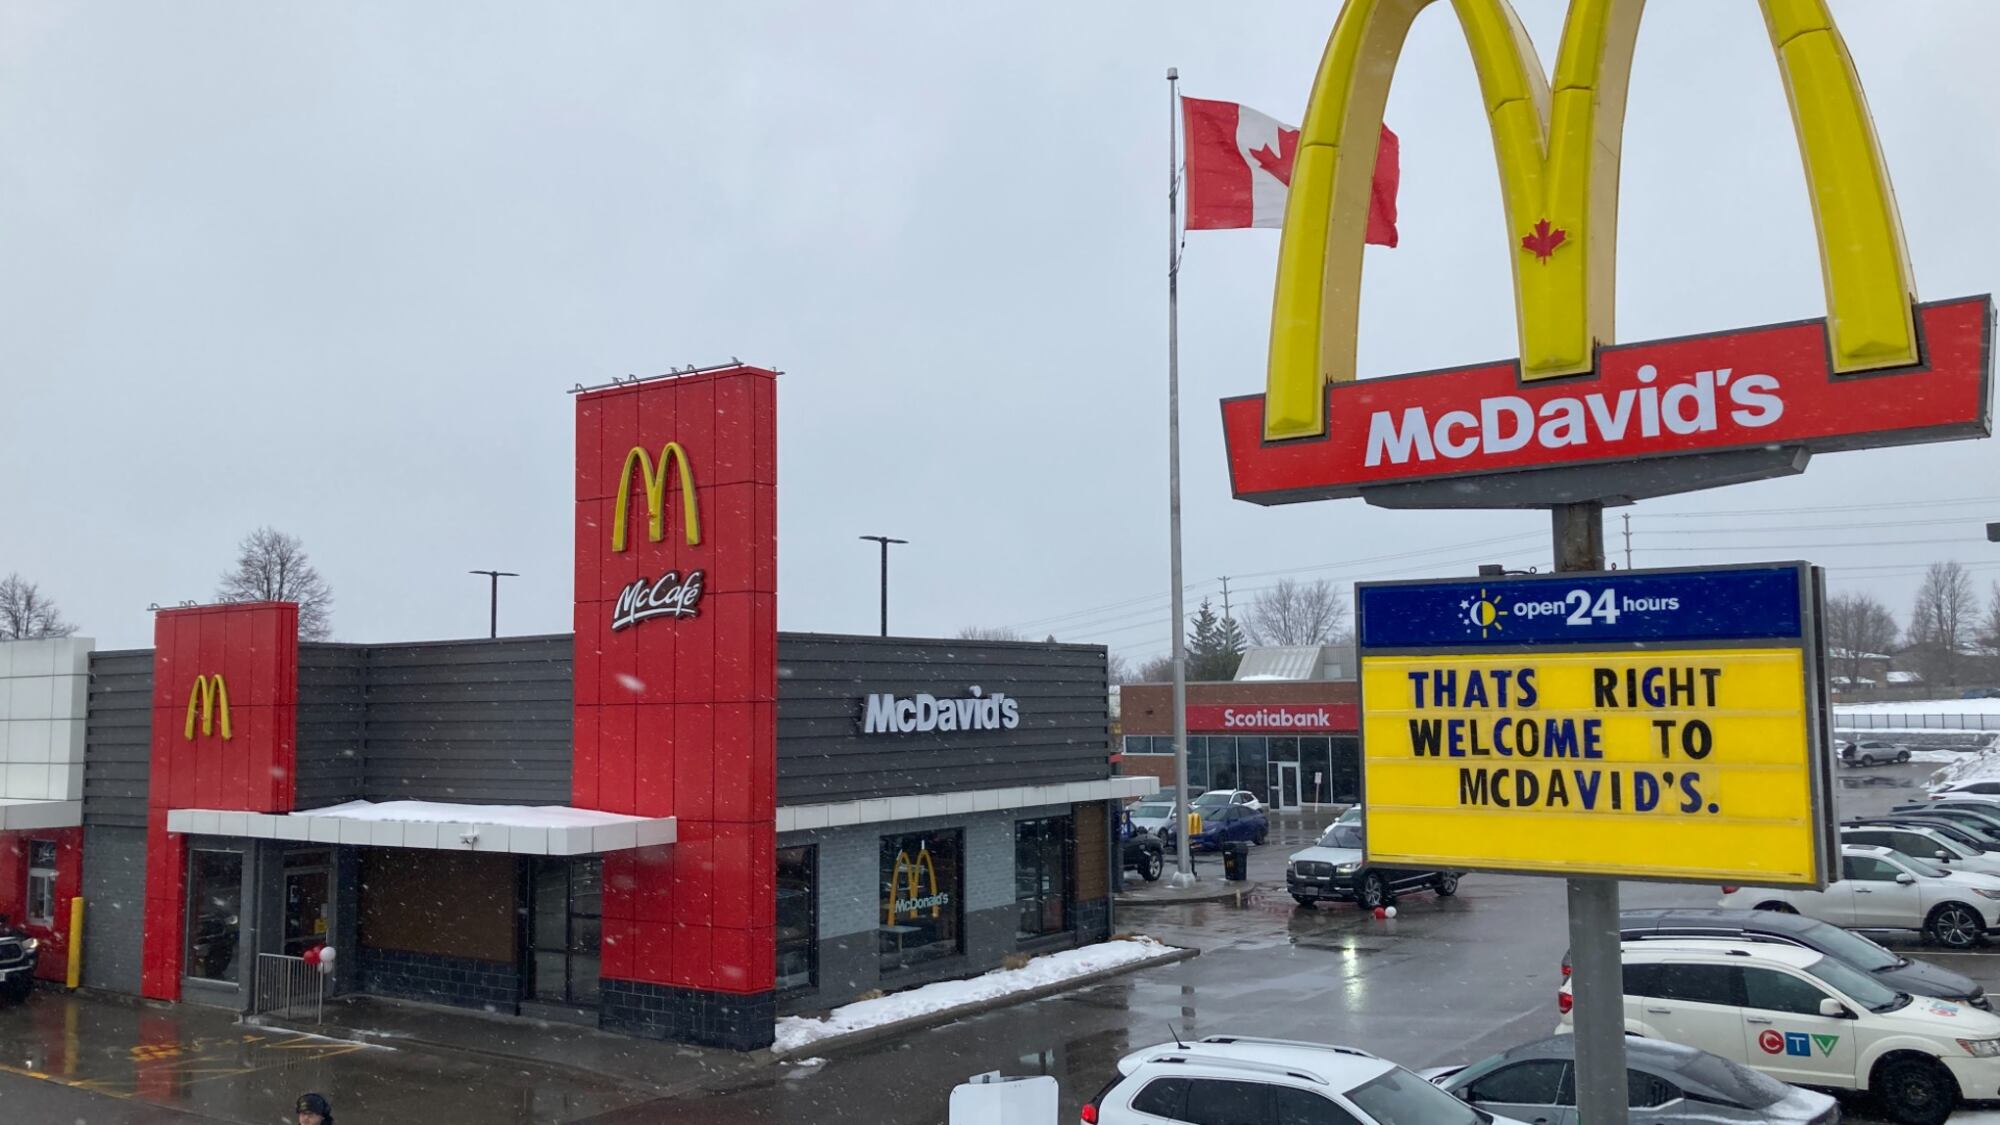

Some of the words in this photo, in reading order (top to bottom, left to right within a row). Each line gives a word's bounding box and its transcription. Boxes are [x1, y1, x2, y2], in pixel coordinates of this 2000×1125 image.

[1364, 364, 1784, 468] McDavid's
[613, 571, 701, 624] McCafé
[1513, 600, 1565, 620] open
[1565, 588, 1620, 626] 24
[1622, 595, 1680, 613] hours
[864, 685, 1020, 733] McDavid's
[1408, 668, 1537, 709] THATS
[1594, 667, 1722, 708] RIGHT
[1224, 708, 1331, 727] Scotiabank
[1409, 717, 1604, 759] WELCOME
[1652, 719, 1713, 760] TO
[1459, 768, 1721, 815] MCDAVID'S.
[1760, 1031, 1838, 1055] CTV
